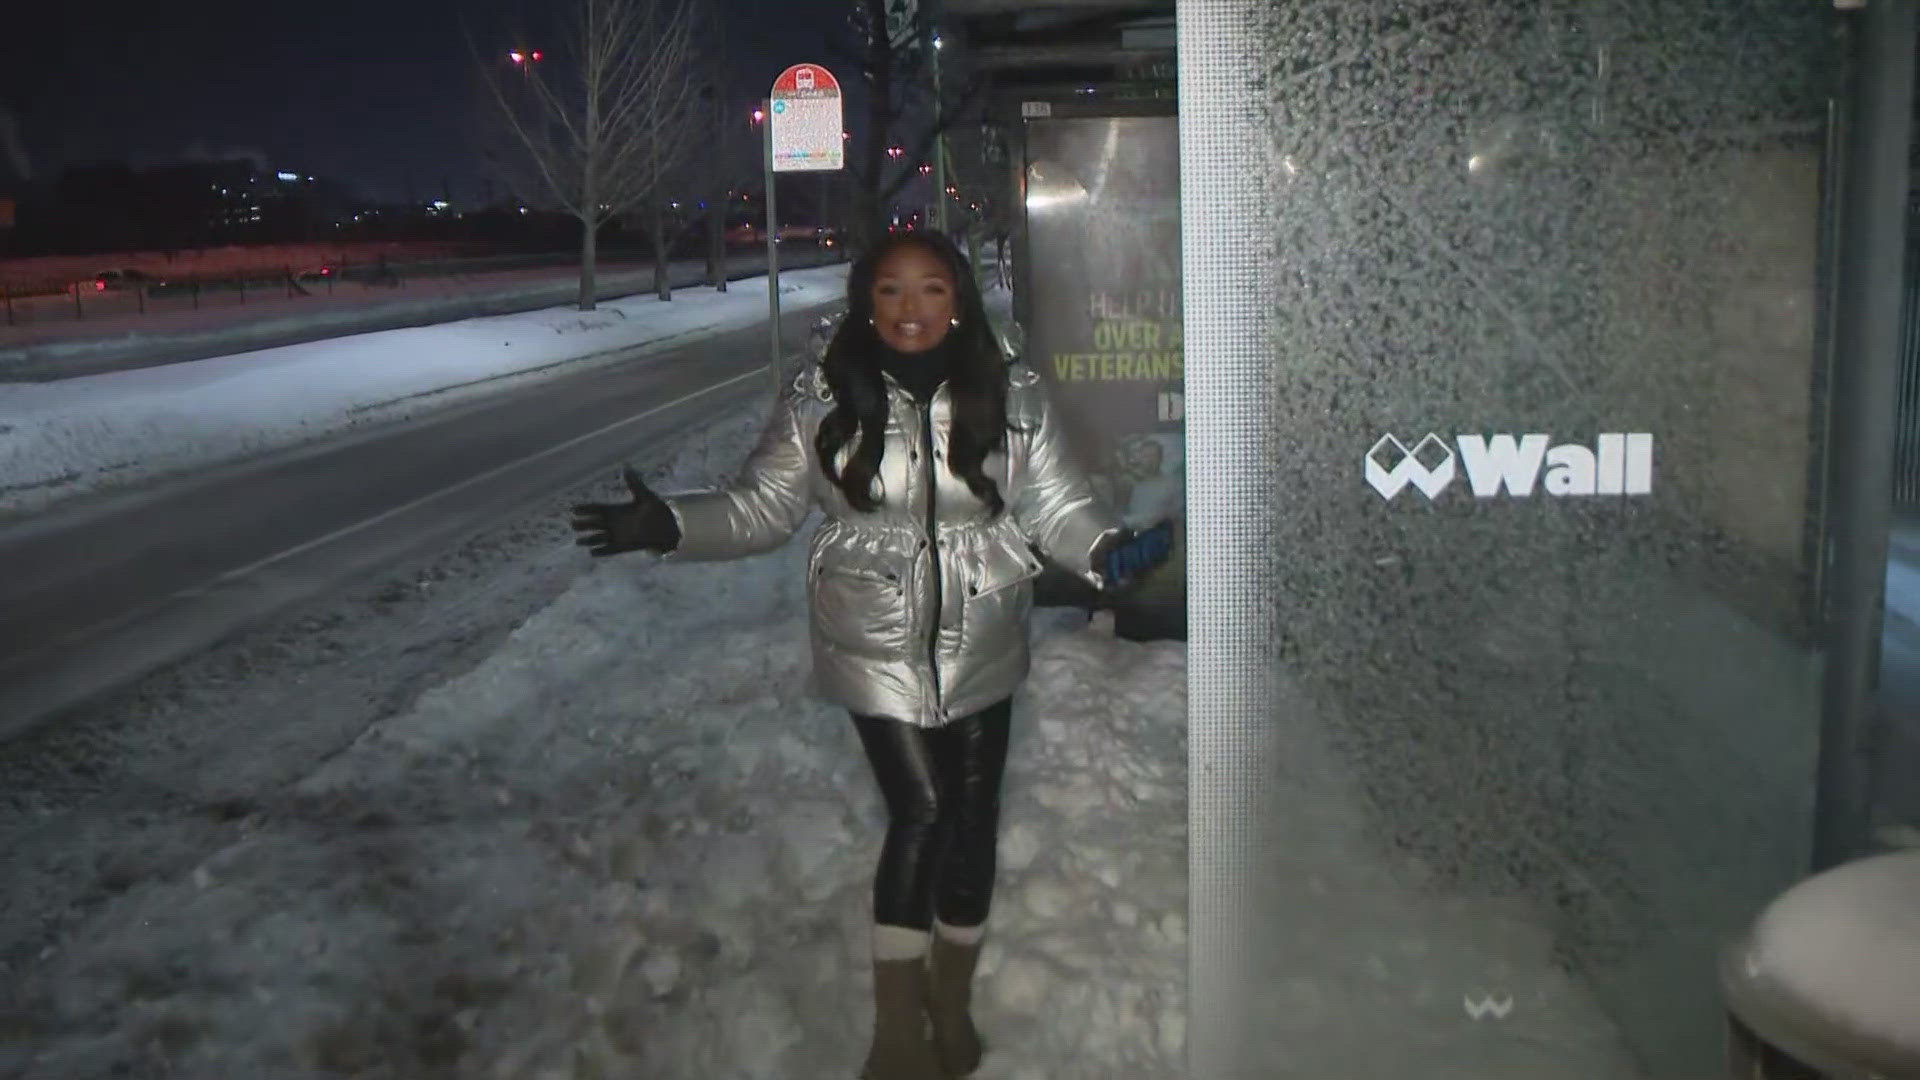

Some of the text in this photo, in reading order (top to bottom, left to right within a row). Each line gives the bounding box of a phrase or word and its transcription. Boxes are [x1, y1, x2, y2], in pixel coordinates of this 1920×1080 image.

[1094, 320, 1160, 349] OVER
[1054, 353, 1184, 381] VETERANS
[1456, 432, 1653, 496] Wall
